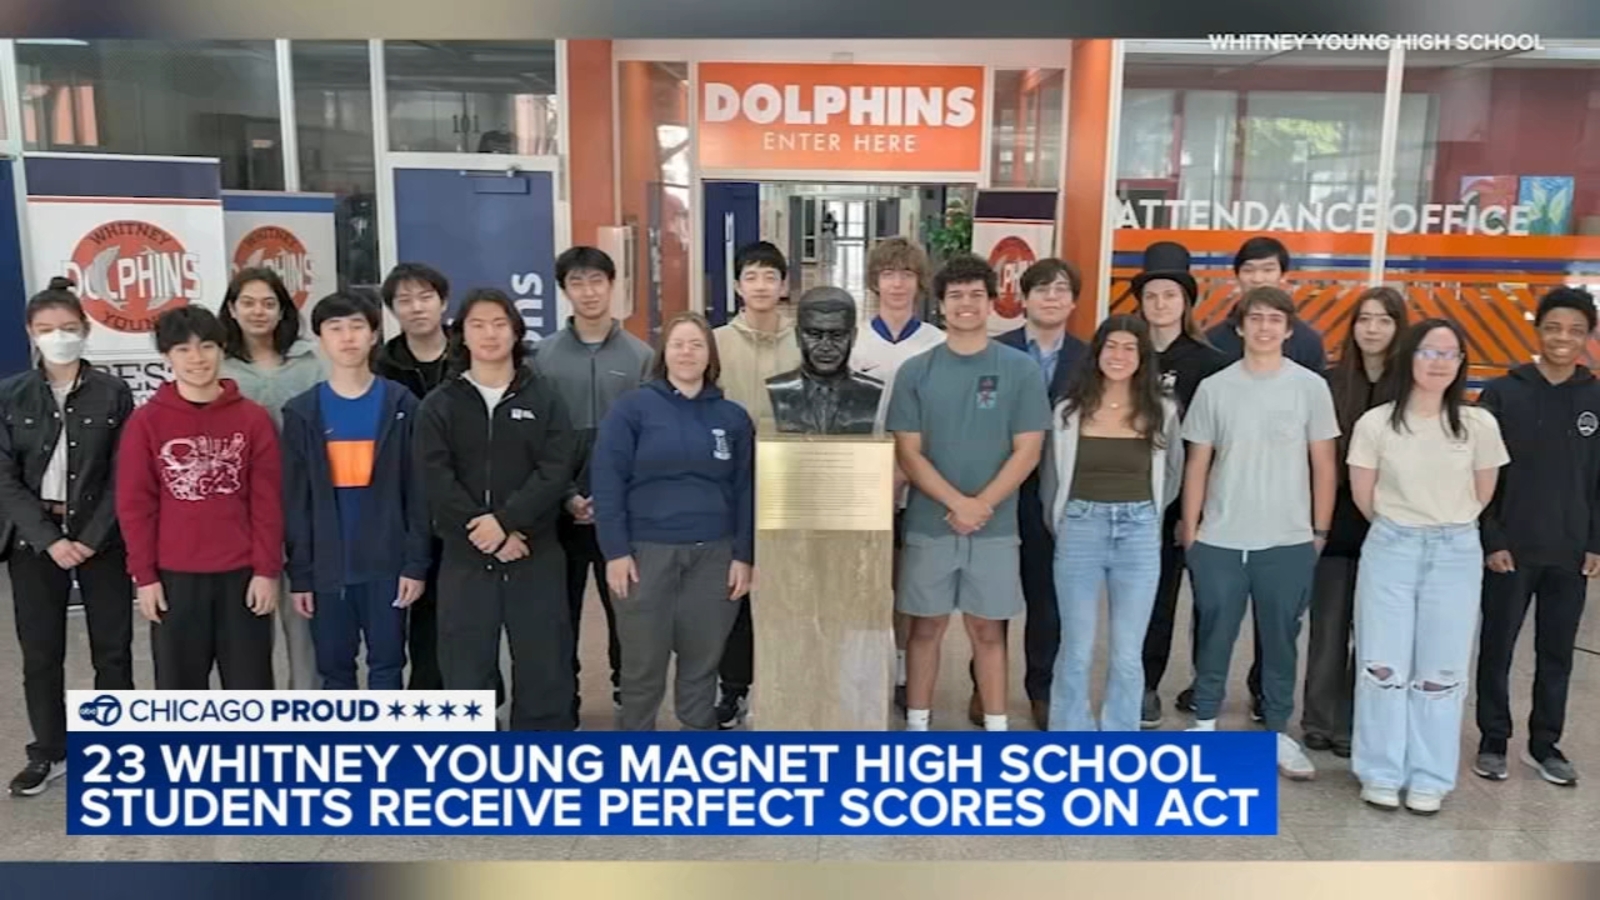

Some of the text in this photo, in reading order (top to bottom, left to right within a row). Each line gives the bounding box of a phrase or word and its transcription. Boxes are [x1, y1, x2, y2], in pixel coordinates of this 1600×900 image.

[704, 83, 977, 127] DOLPHINS
[763, 131, 918, 153] ENTER HERE
[1117, 198, 1532, 236] ATTENDANCE OFFICE
[90, 222, 173, 245] WHITNEY
